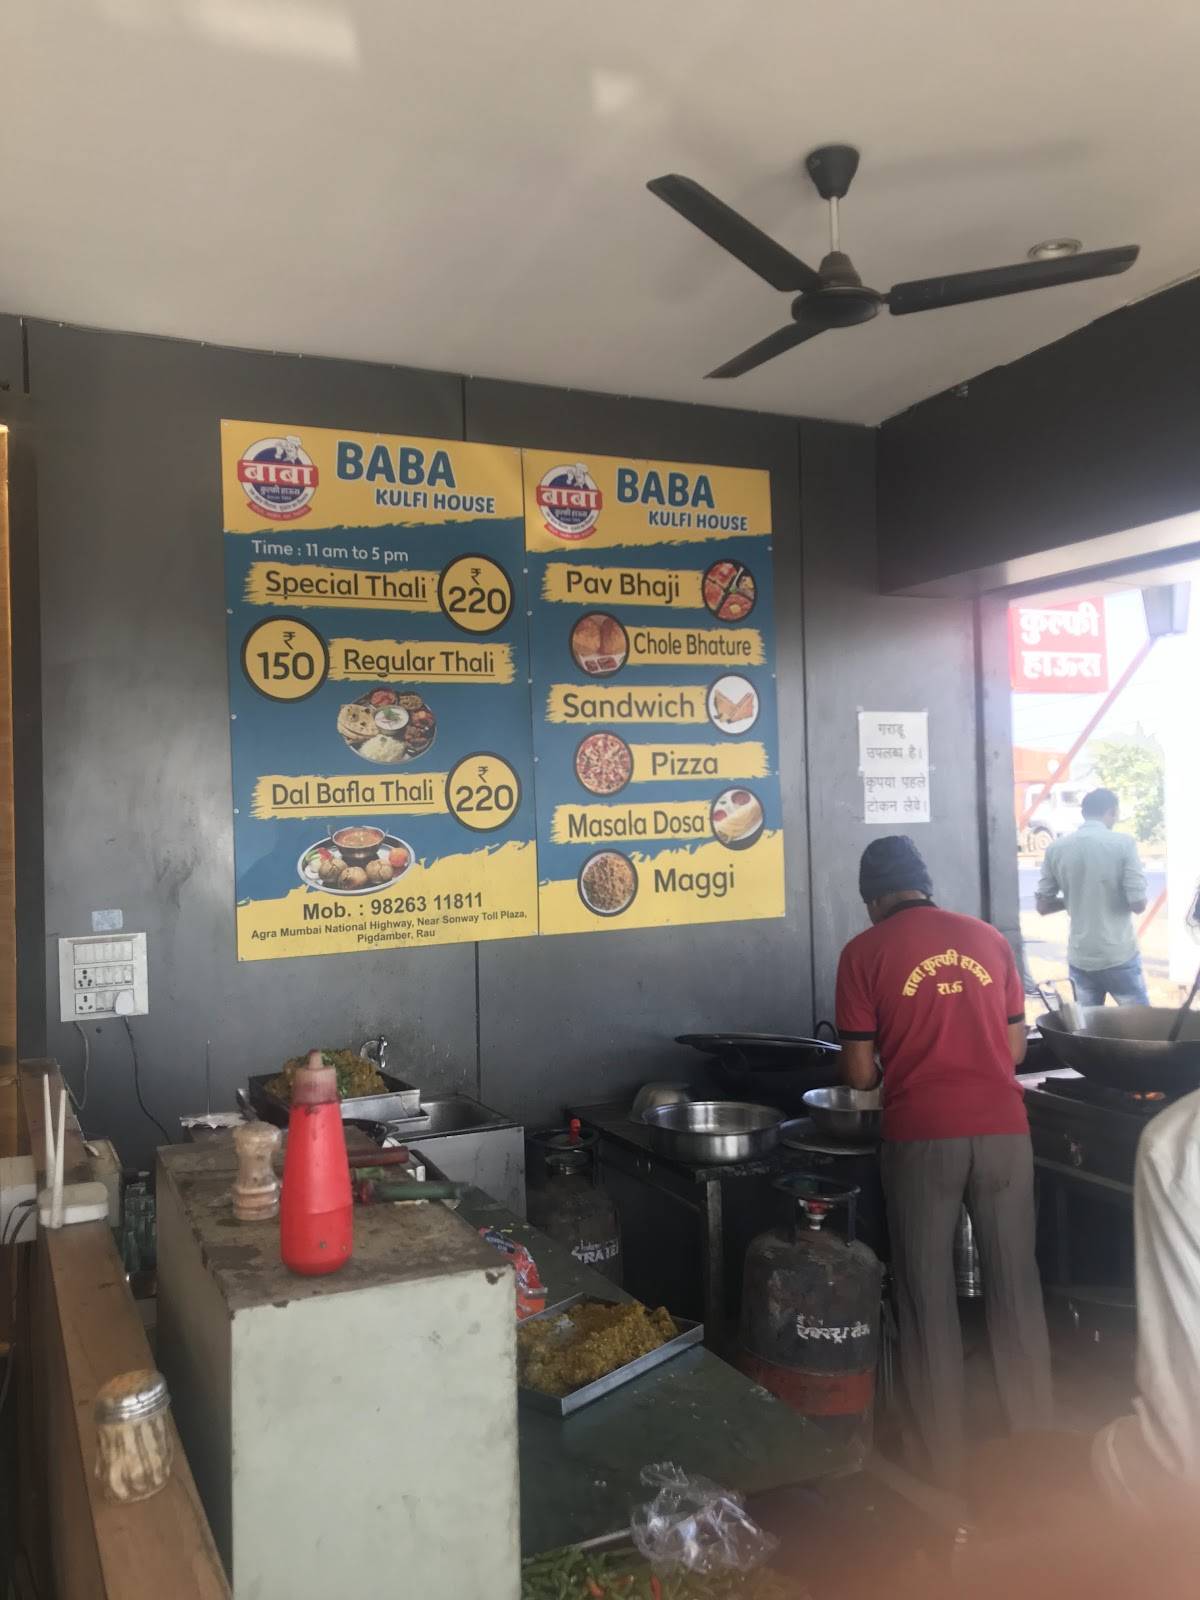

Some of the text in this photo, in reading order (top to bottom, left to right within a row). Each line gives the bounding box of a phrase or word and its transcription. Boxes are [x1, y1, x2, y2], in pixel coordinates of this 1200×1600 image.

[243, 462, 313, 487] बाबा
[336, 440, 457, 489] BABA
[375, 488, 496, 514] KULFI HOUSE
[541, 487, 597, 508] बाबा
[616, 468, 715, 508] BABA
[649, 510, 748, 532] KULFI HOUSE
[252, 539, 293, 556] Time
[306, 543, 320, 557] 11
[322, 546, 349, 560] am
[352, 546, 369, 560] to
[371, 547, 380, 561] 5
[384, 549, 409, 564] pm
[265, 570, 427, 600] Special Thali
[566, 571, 679, 604] Pav Bhaji
[448, 586, 508, 615] 220
[1020, 601, 1101, 645] कुल्फी
[633, 632, 752, 656] Chole Bhature
[256, 652, 315, 680] 150
[343, 649, 495, 678] Regular Thali
[563, 693, 694, 718] Sandwich
[651, 751, 718, 776] Pizza
[271, 779, 434, 806] Dal Bafla Thali
[455, 784, 514, 812] 220
[866, 776, 896, 793] कृपया
[568, 810, 705, 838] Masala Dosa
[654, 864, 735, 898] Maggi
[303, 902, 352, 921] Mob.
[371, 896, 427, 915] 98263
[433, 892, 483, 910] 11811
[251, 910, 528, 941] Agra Mumbai National Highway, Near Sonway Toll Plaza,
[357, 929, 436, 944] Pigdamber, Rau
[902, 966, 926, 997] बाबा
[920, 948, 959, 976] कुल्फी
